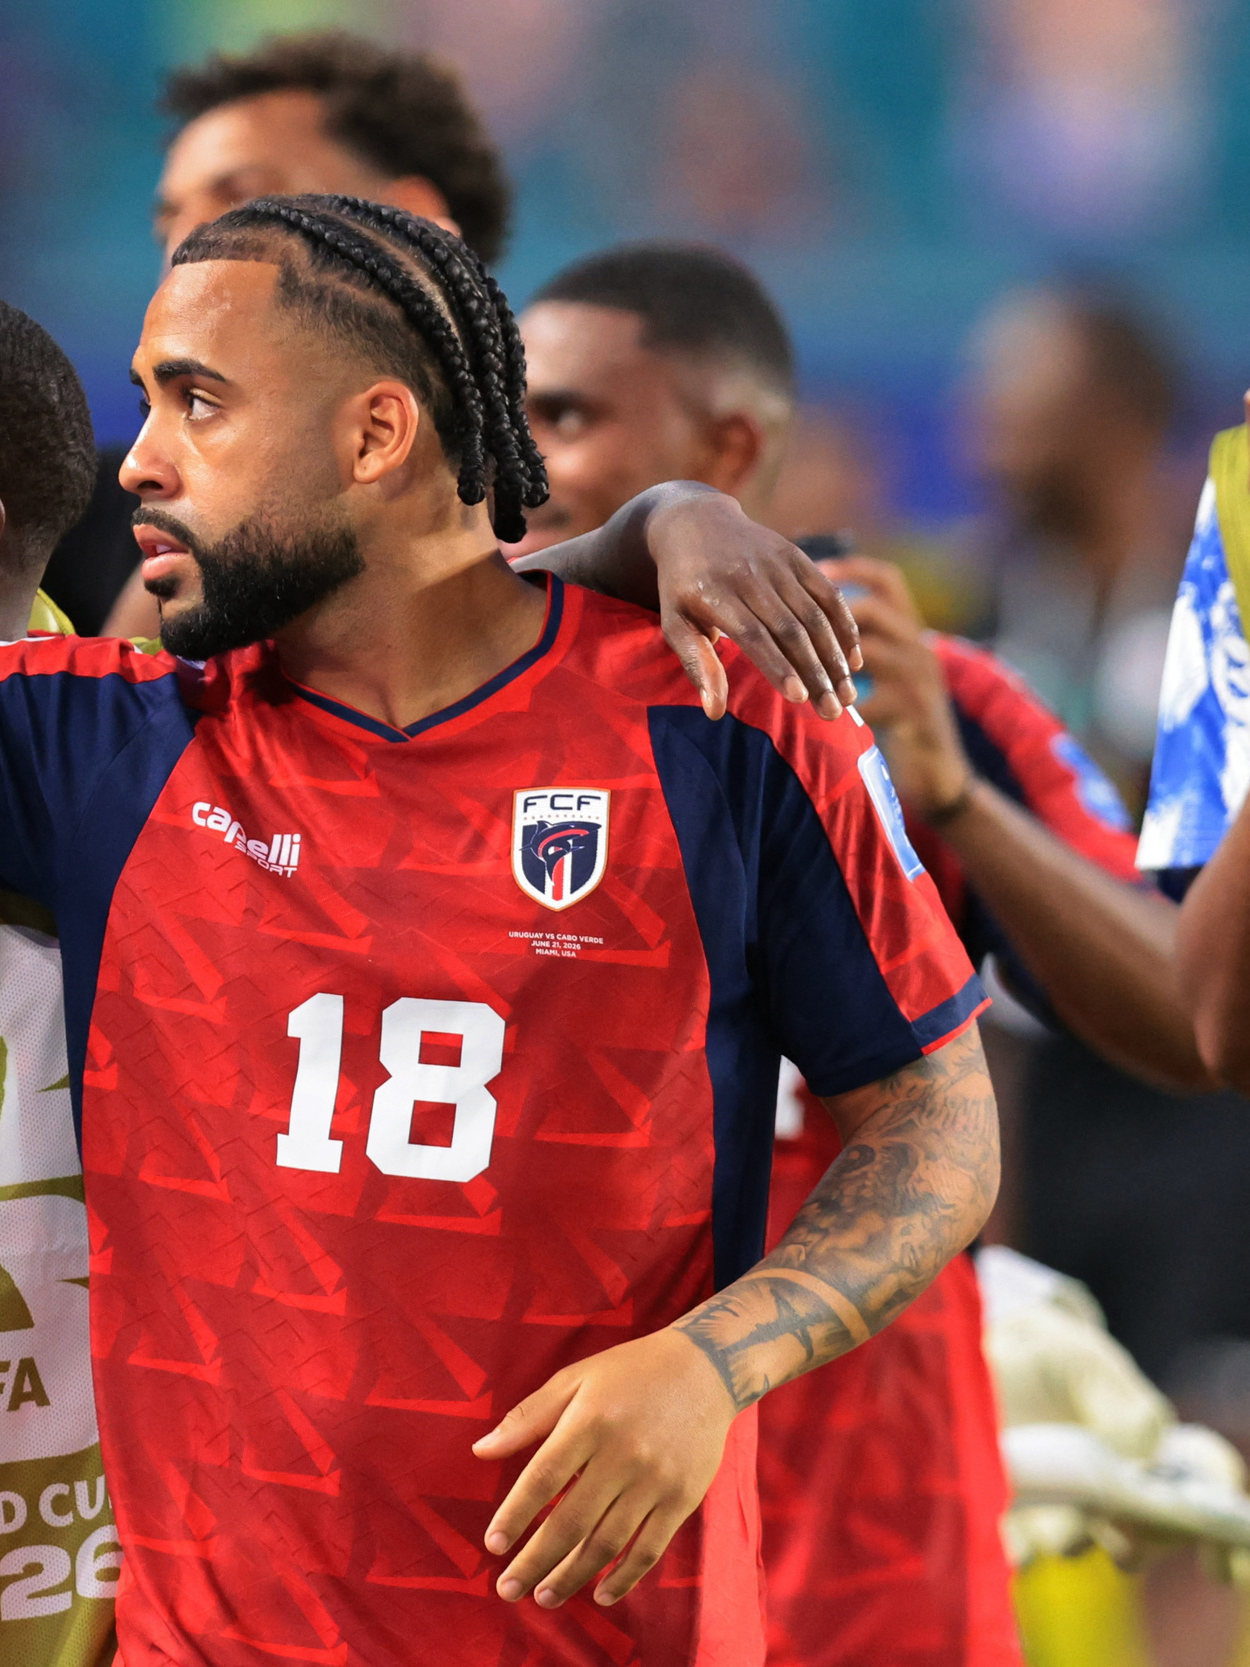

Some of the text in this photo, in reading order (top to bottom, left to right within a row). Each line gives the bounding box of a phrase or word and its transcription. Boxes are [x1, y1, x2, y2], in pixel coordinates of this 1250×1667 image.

[523, 794, 601, 813] FCF
[192, 801, 301, 867] capelli
[508, 931, 544, 940] URUGUAY
[556, 933, 578, 941] CABO
[579, 935, 604, 944] VERDE
[531, 940, 581, 950] JUNE 21, 2026
[535, 948, 560, 957] MIAMI,
[276, 992, 506, 1183] 18
[39, 1474, 113, 1527] CU
